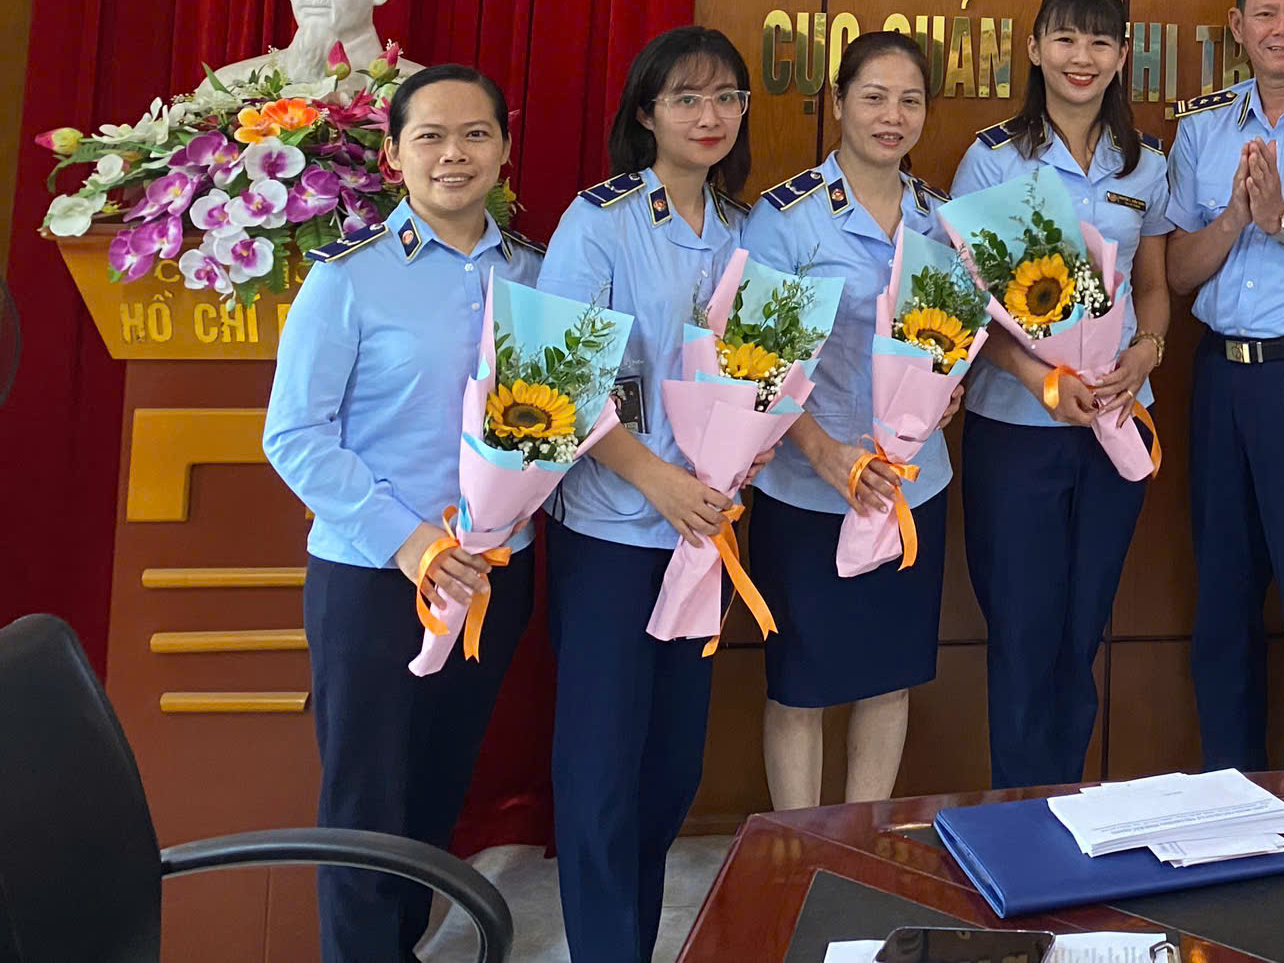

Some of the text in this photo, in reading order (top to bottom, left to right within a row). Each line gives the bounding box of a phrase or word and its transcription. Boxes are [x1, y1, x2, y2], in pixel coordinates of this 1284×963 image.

[1125, 22, 1178, 120] HỊ
[119, 290, 173, 342] HỒ
[194, 293, 259, 343] CHÍ
